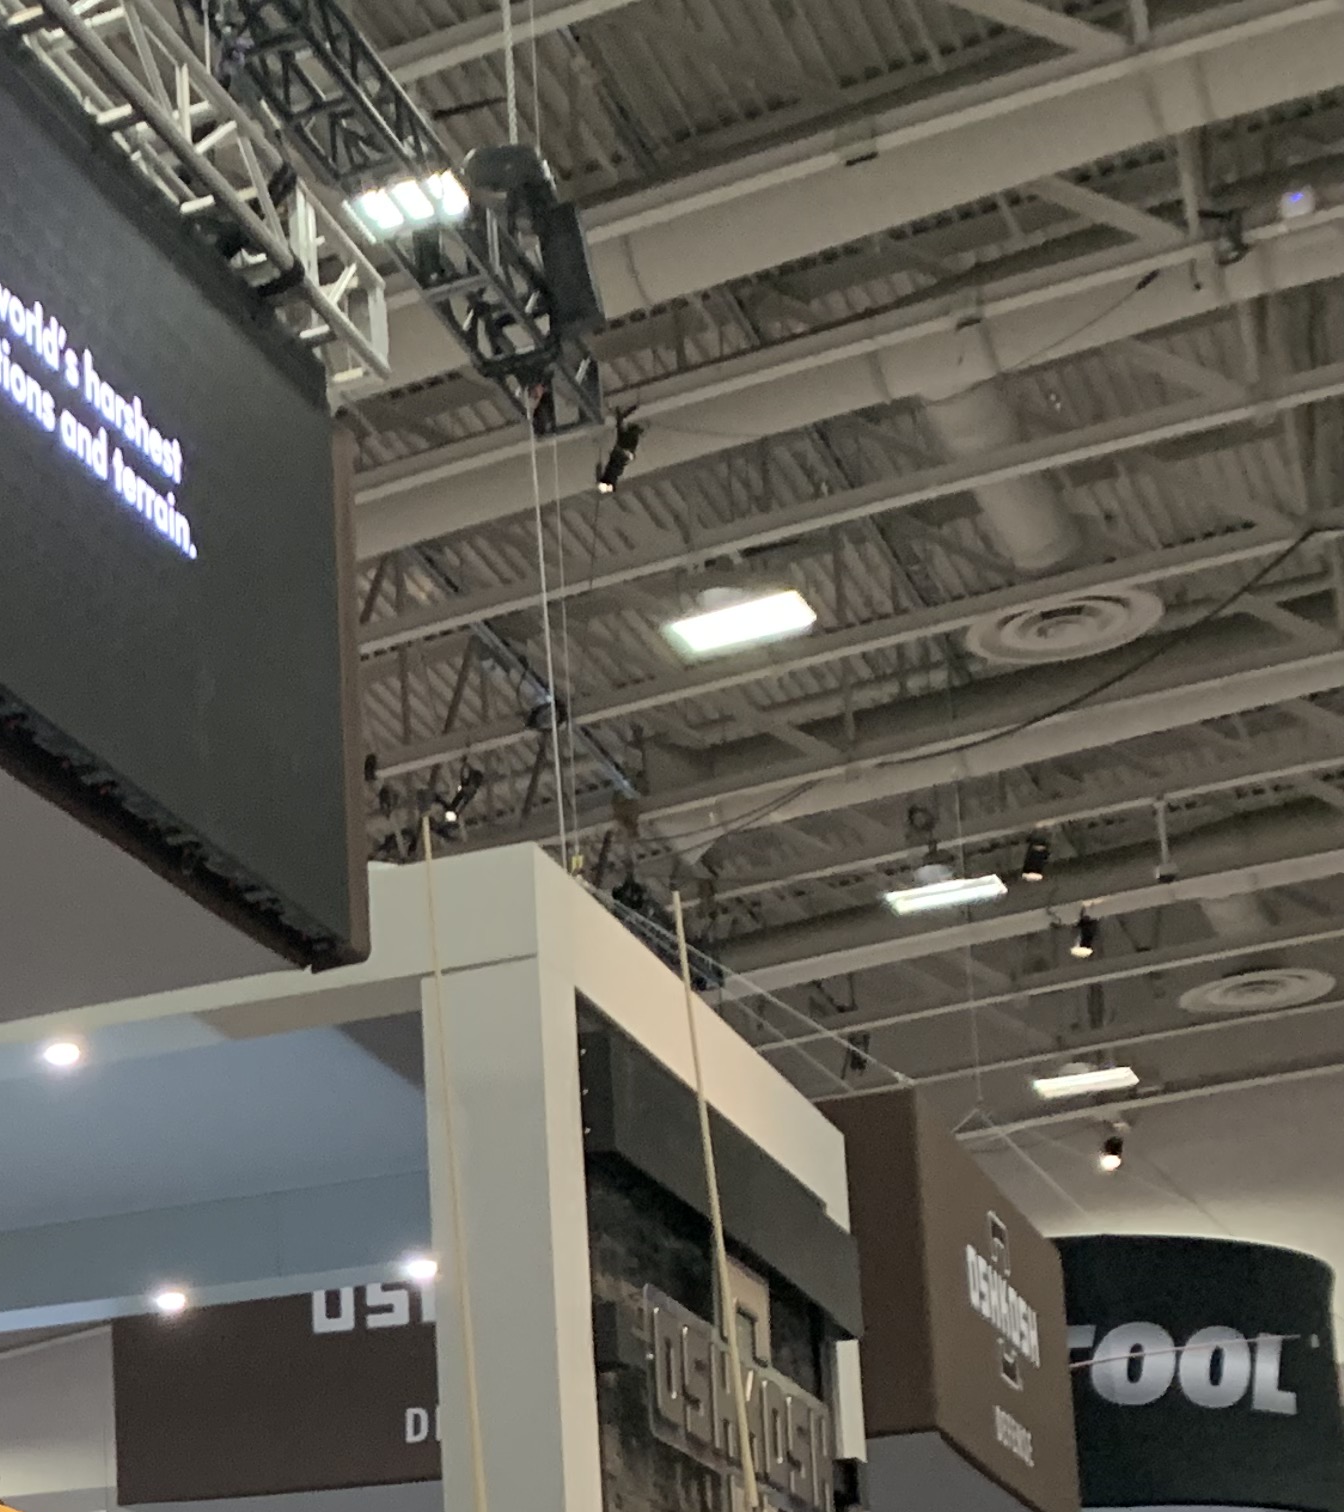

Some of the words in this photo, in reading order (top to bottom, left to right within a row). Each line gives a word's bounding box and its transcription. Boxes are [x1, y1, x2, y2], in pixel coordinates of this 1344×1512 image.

[83, 348, 183, 484] harshest
[61, 409, 109, 480] and
[113, 446, 198, 560] terrain.
[405, 1406, 441, 1444] D
